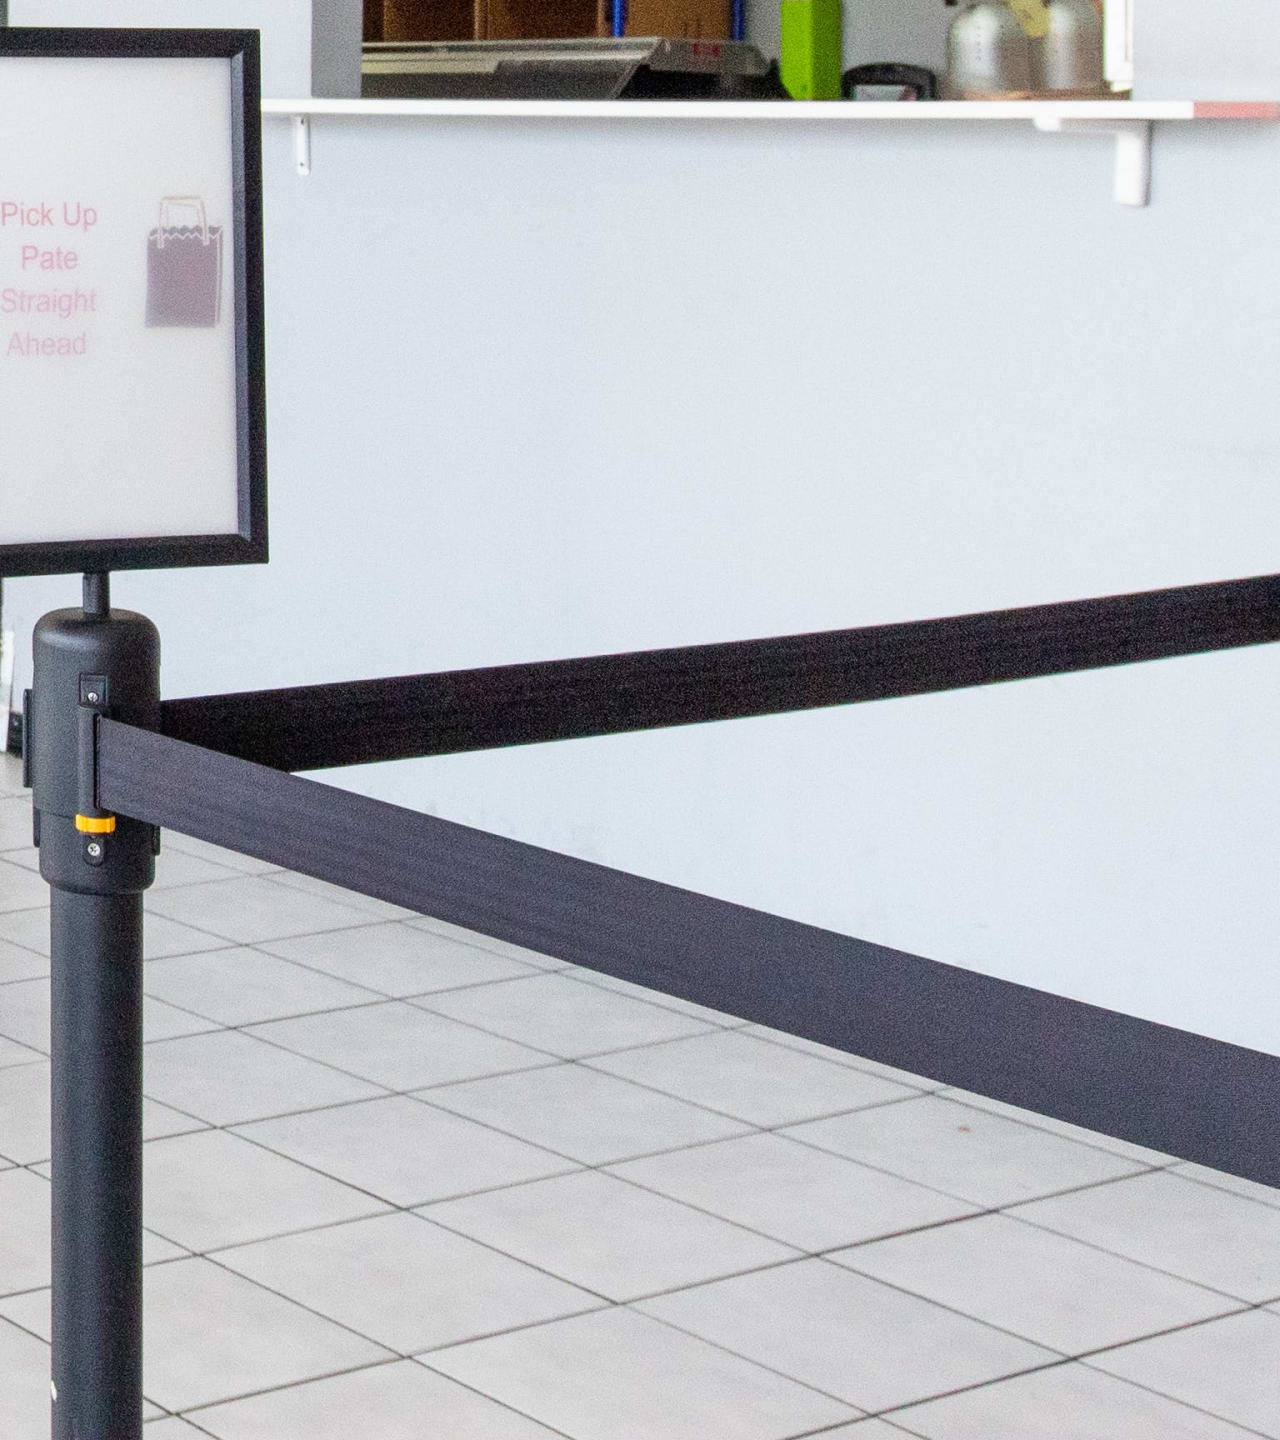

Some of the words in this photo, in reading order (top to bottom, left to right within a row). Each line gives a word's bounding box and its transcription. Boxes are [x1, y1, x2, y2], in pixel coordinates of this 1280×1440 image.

[0, 201, 54, 228] Pick
[63, 201, 98, 233] Up
[20, 245, 79, 270] Pate
[0, 288, 97, 320] Straight
[6, 331, 88, 356] Ahead
